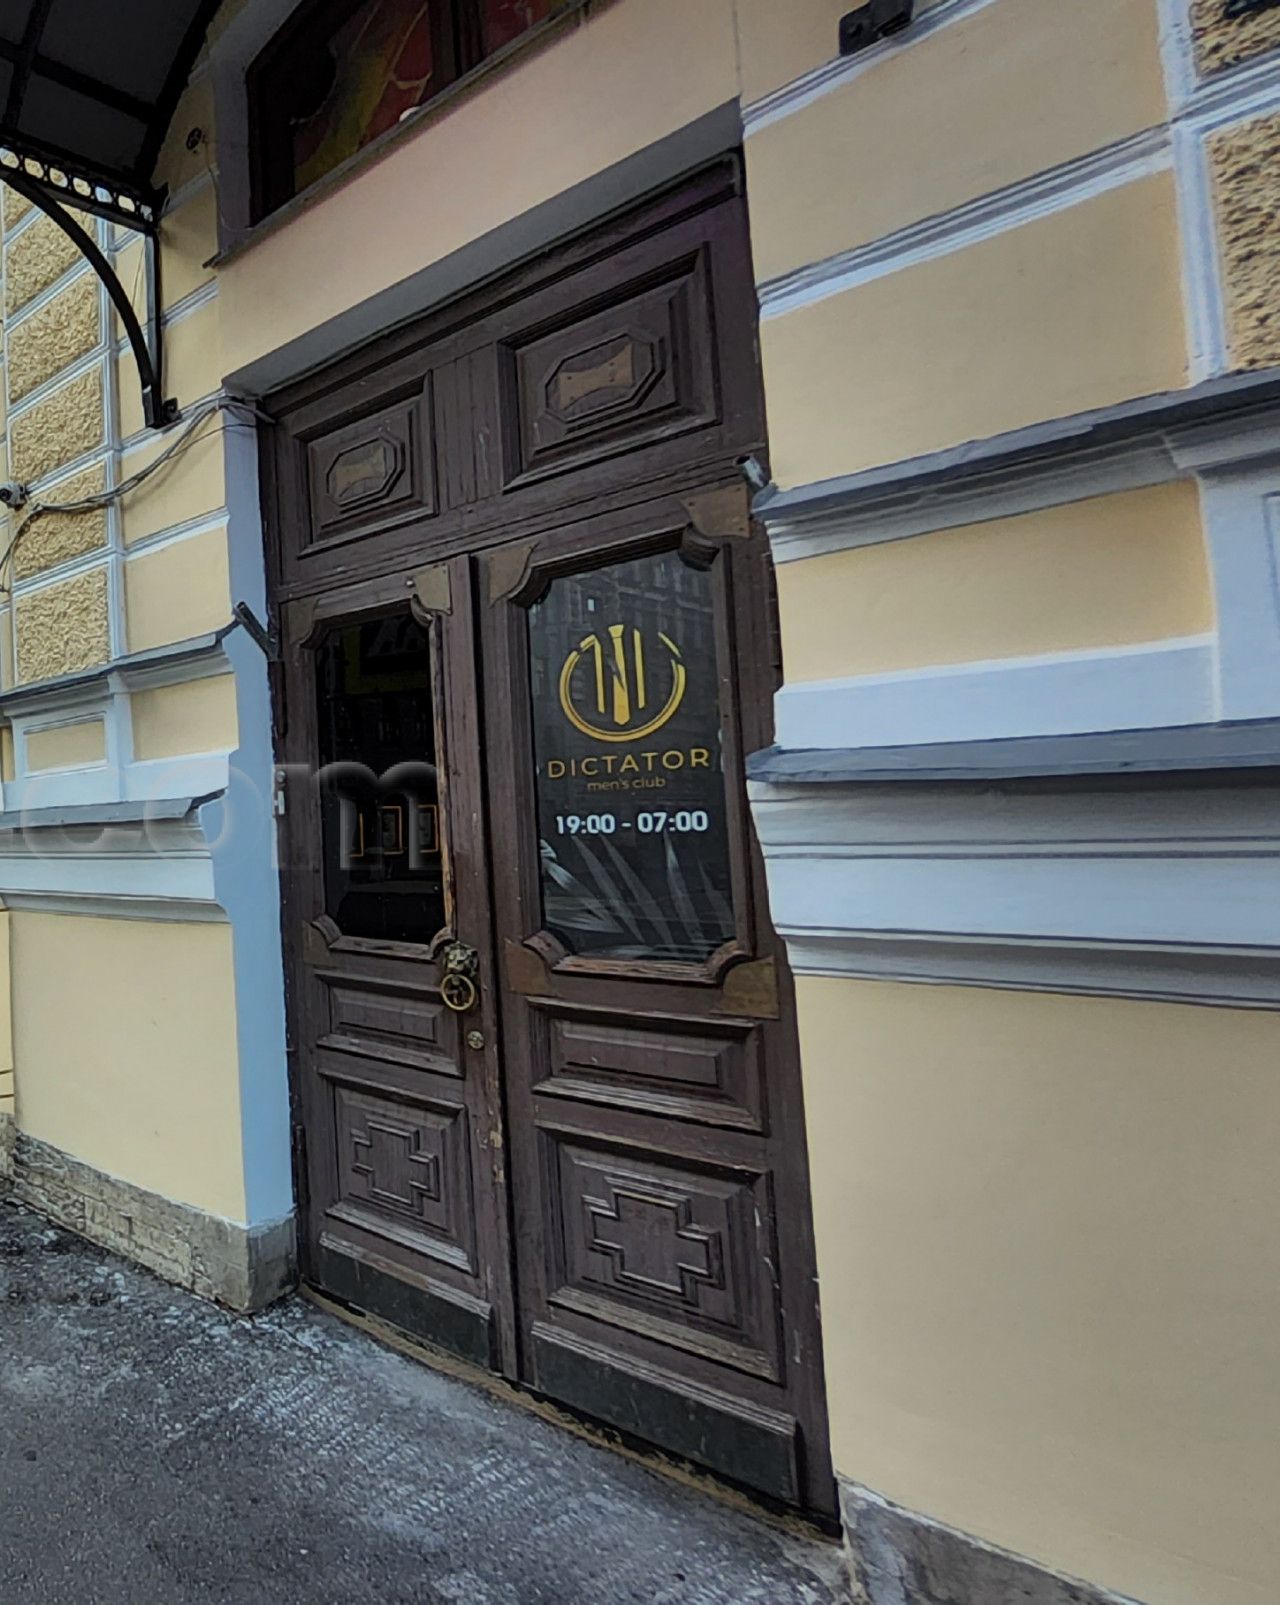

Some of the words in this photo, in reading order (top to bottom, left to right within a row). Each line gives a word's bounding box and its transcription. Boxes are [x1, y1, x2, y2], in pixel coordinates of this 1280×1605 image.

[547, 748, 710, 779] DICTATOR
[587, 778, 630, 792] men's
[632, 776, 666, 789] club
[555, 813, 616, 835] 19:00
[636, 810, 709, 834] 07:00
